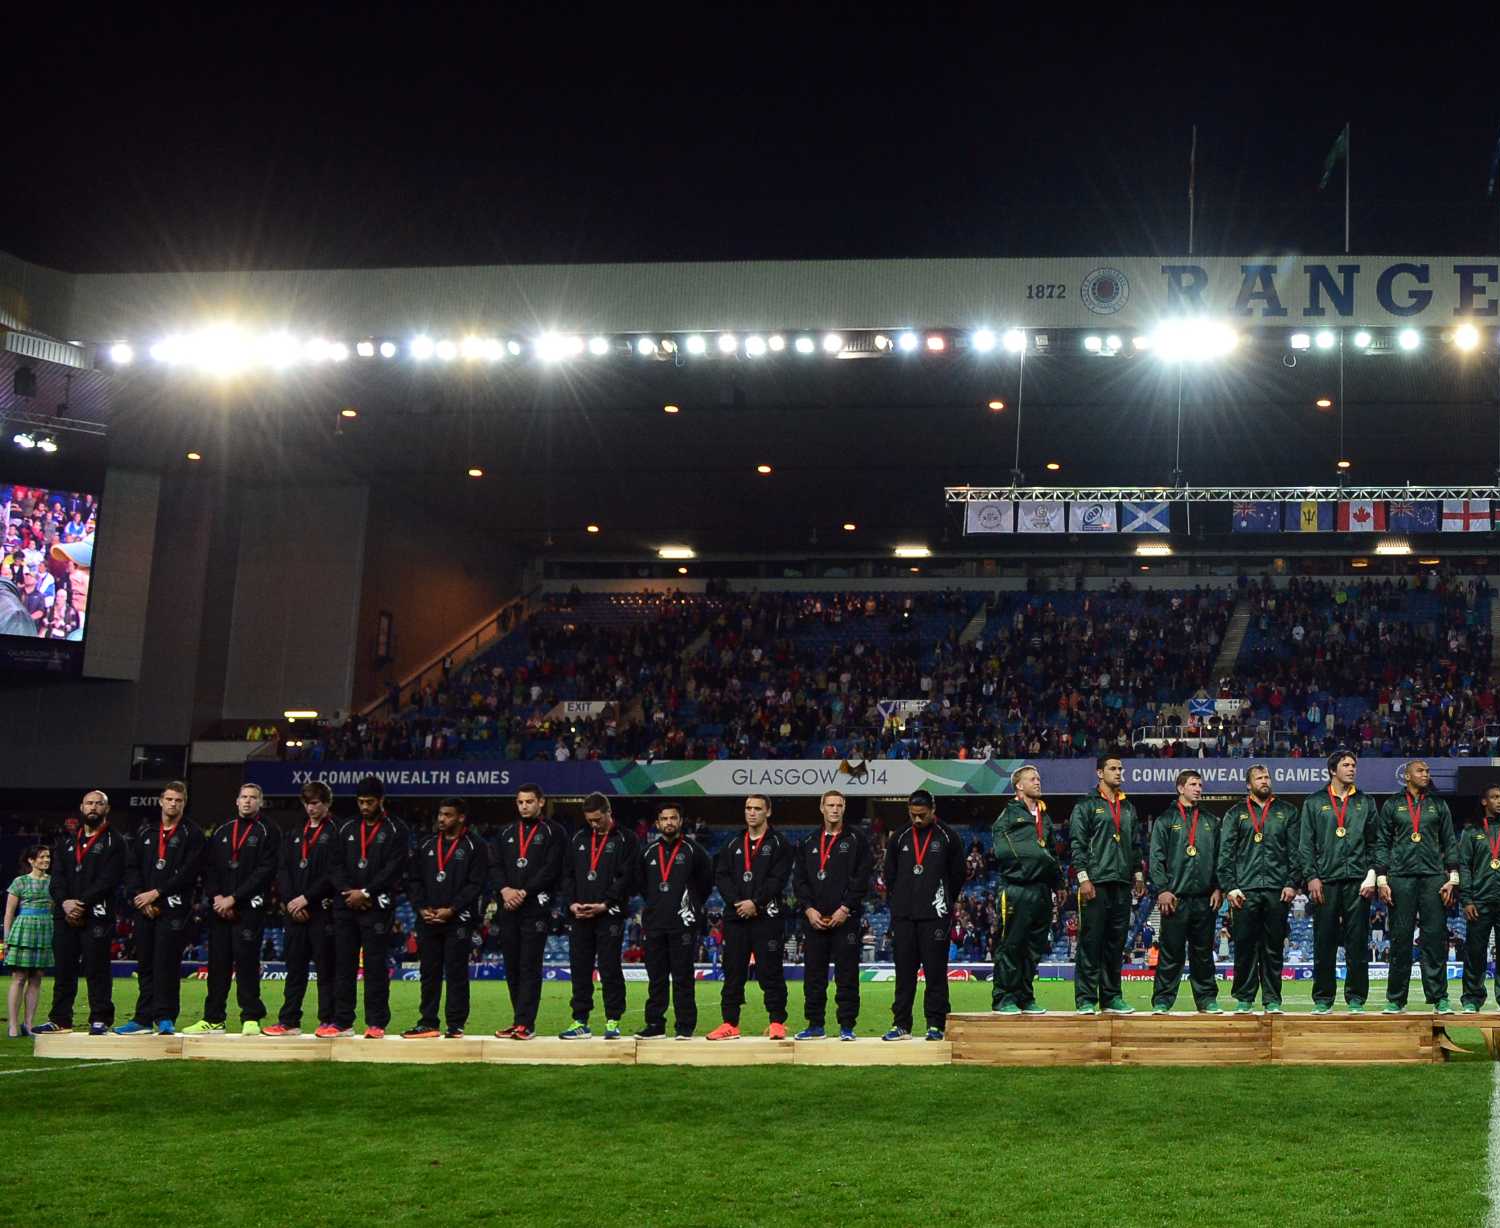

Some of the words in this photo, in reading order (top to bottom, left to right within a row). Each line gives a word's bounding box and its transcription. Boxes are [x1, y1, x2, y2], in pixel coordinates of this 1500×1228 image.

[1026, 284, 1066, 299] 1872
[567, 702, 592, 712] EXIT
[292, 771, 313, 784] XX
[455, 771, 509, 785] GAMES
[732, 769, 839, 785] GLASGOW
[1275, 769, 1330, 782] GAMES
[130, 797, 160, 807] EXIT
